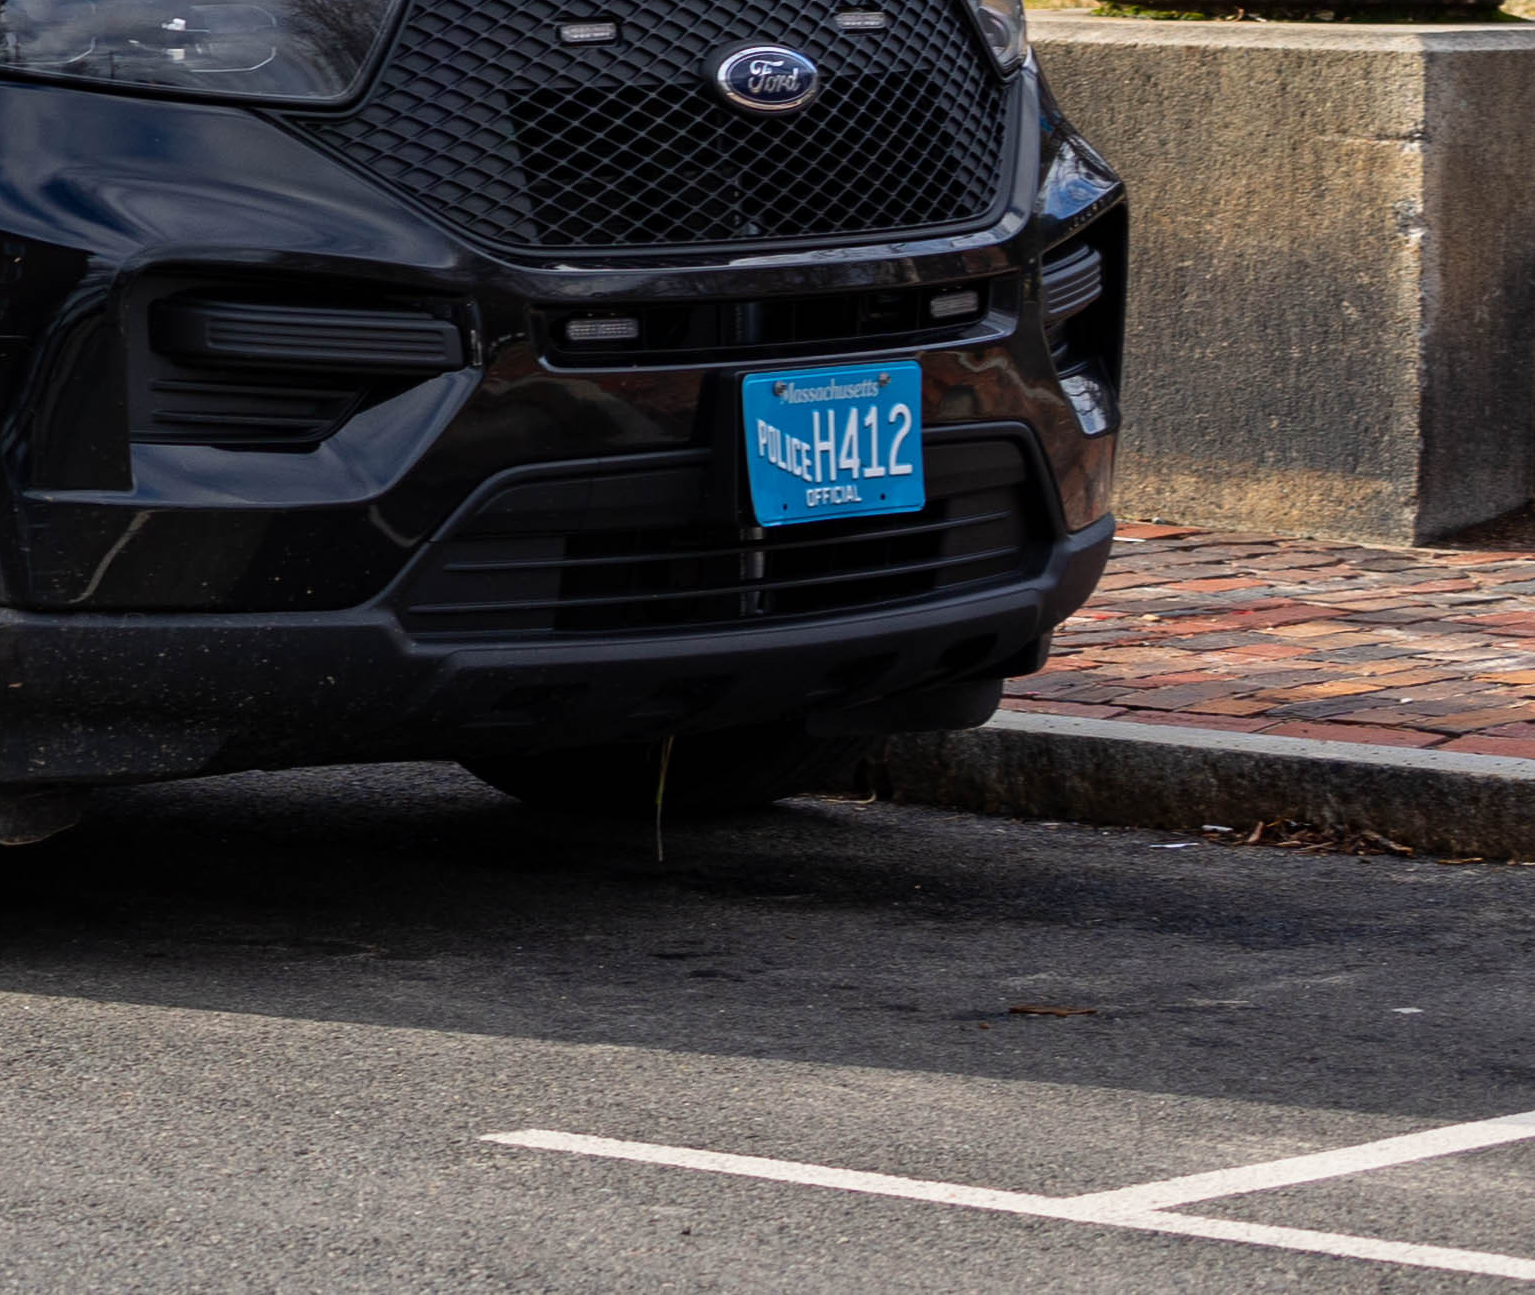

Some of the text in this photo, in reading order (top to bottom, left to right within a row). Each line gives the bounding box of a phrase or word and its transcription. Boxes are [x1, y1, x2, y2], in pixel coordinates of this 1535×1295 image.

[747, 60, 801, 94] Ford
[781, 379, 879, 403] Massachusetts
[757, 403, 913, 483] POLICE H412
[806, 485, 862, 507] OFFICIAL
